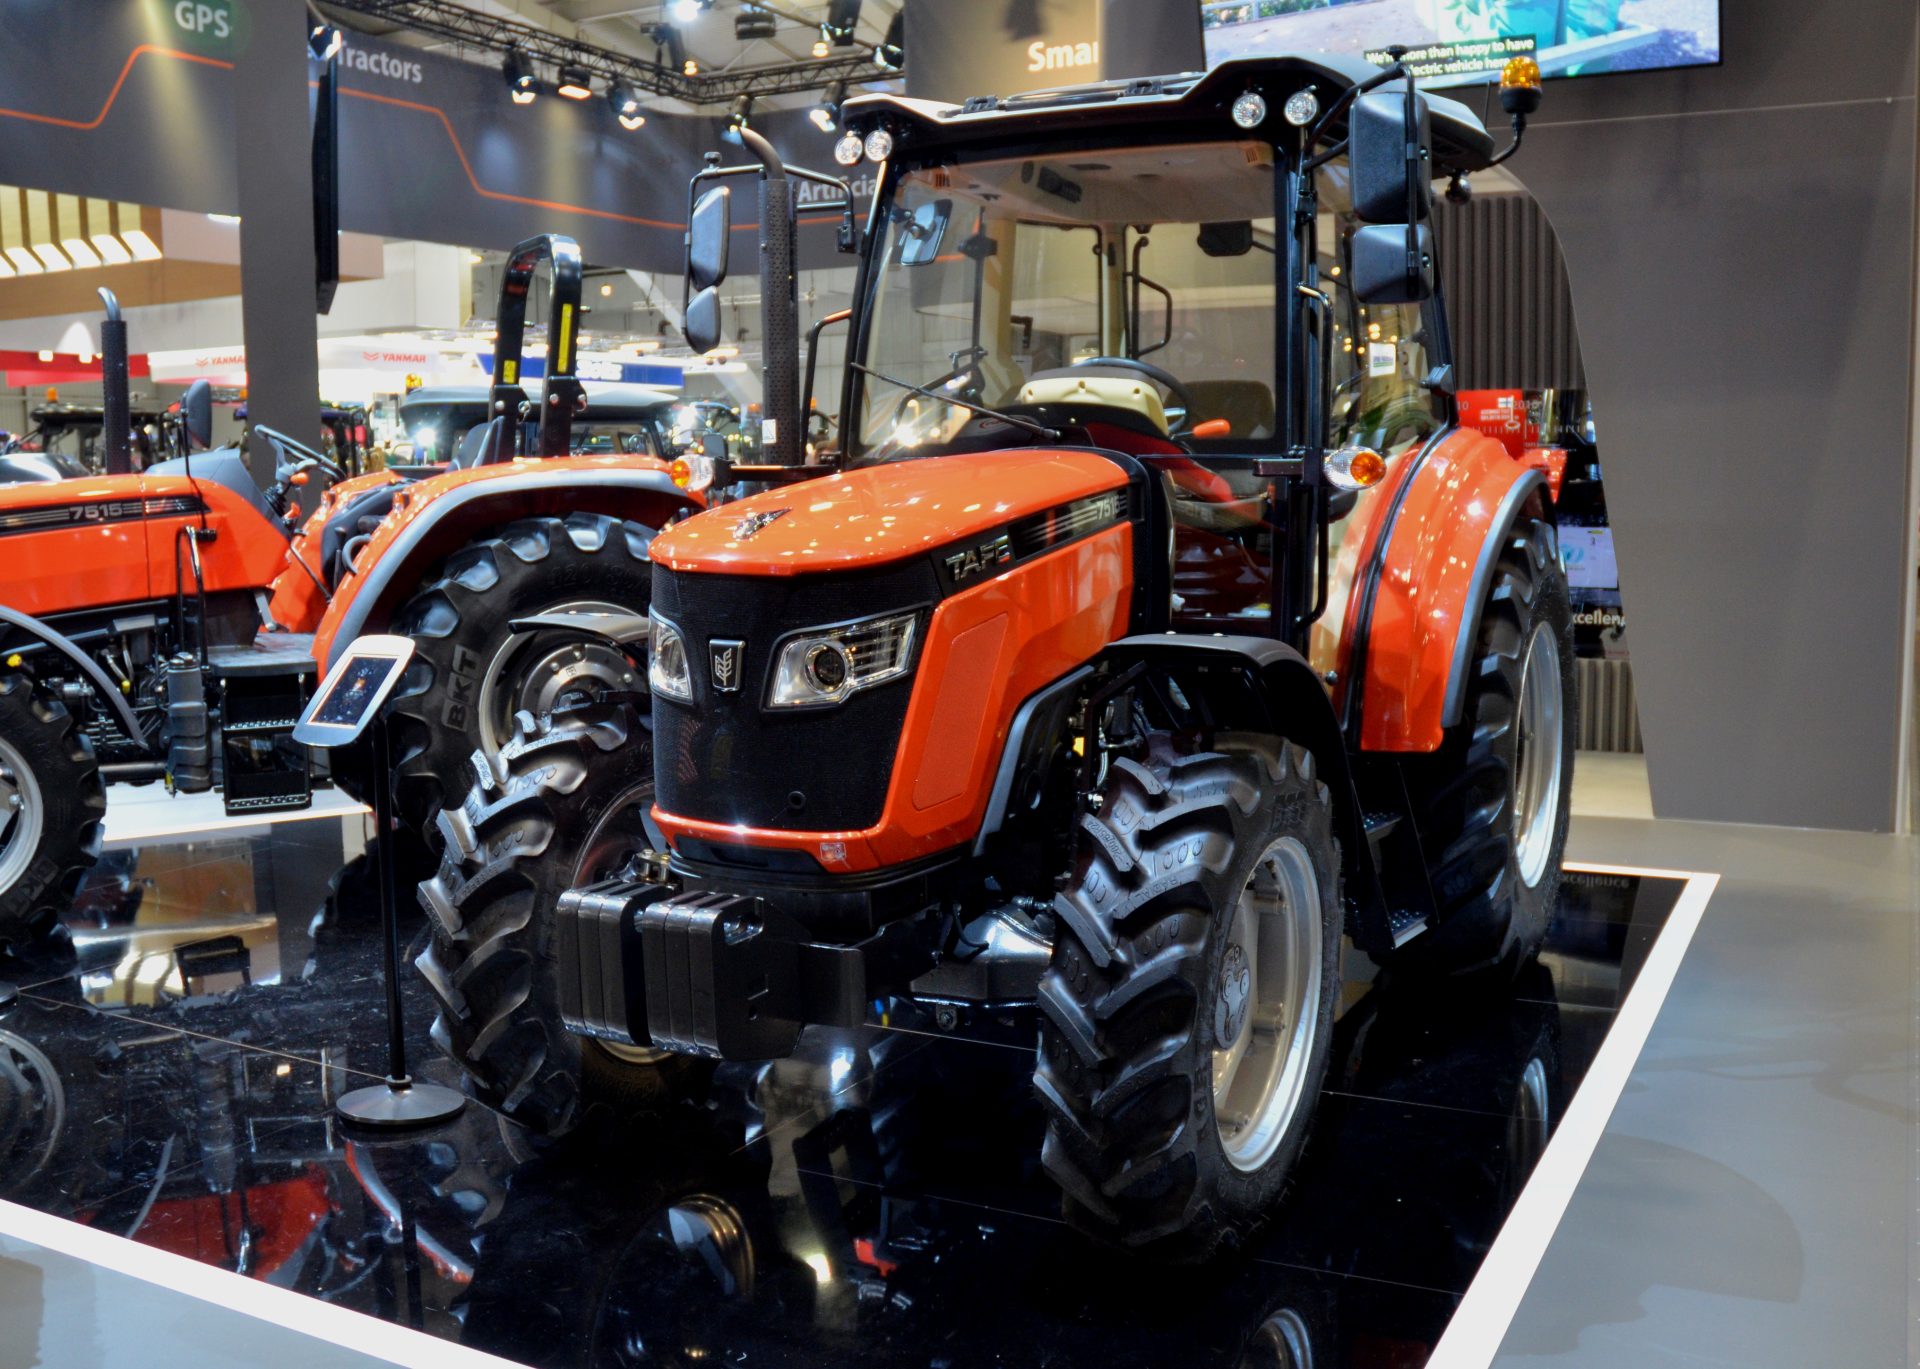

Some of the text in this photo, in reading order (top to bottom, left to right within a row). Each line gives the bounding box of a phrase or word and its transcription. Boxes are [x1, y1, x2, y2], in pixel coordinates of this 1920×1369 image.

[175, 0, 230, 38] GPS
[1428, 46, 1454, 59] than
[1455, 43, 1490, 57] happy
[1493, 41, 1505, 53] to
[1506, 38, 1534, 51] have
[1410, 62, 1443, 76] lectric
[1444, 59, 1484, 73] vehicle
[798, 174, 877, 202] Artifcia
[211, 356, 245, 366] YANMA
[383, 352, 427, 363] YANMAR
[69, 503, 123, 520] 7515
[1097, 496, 1121, 521] 7515
[945, 534, 1011, 581] TAFE
[442, 644, 481, 732] BKT
